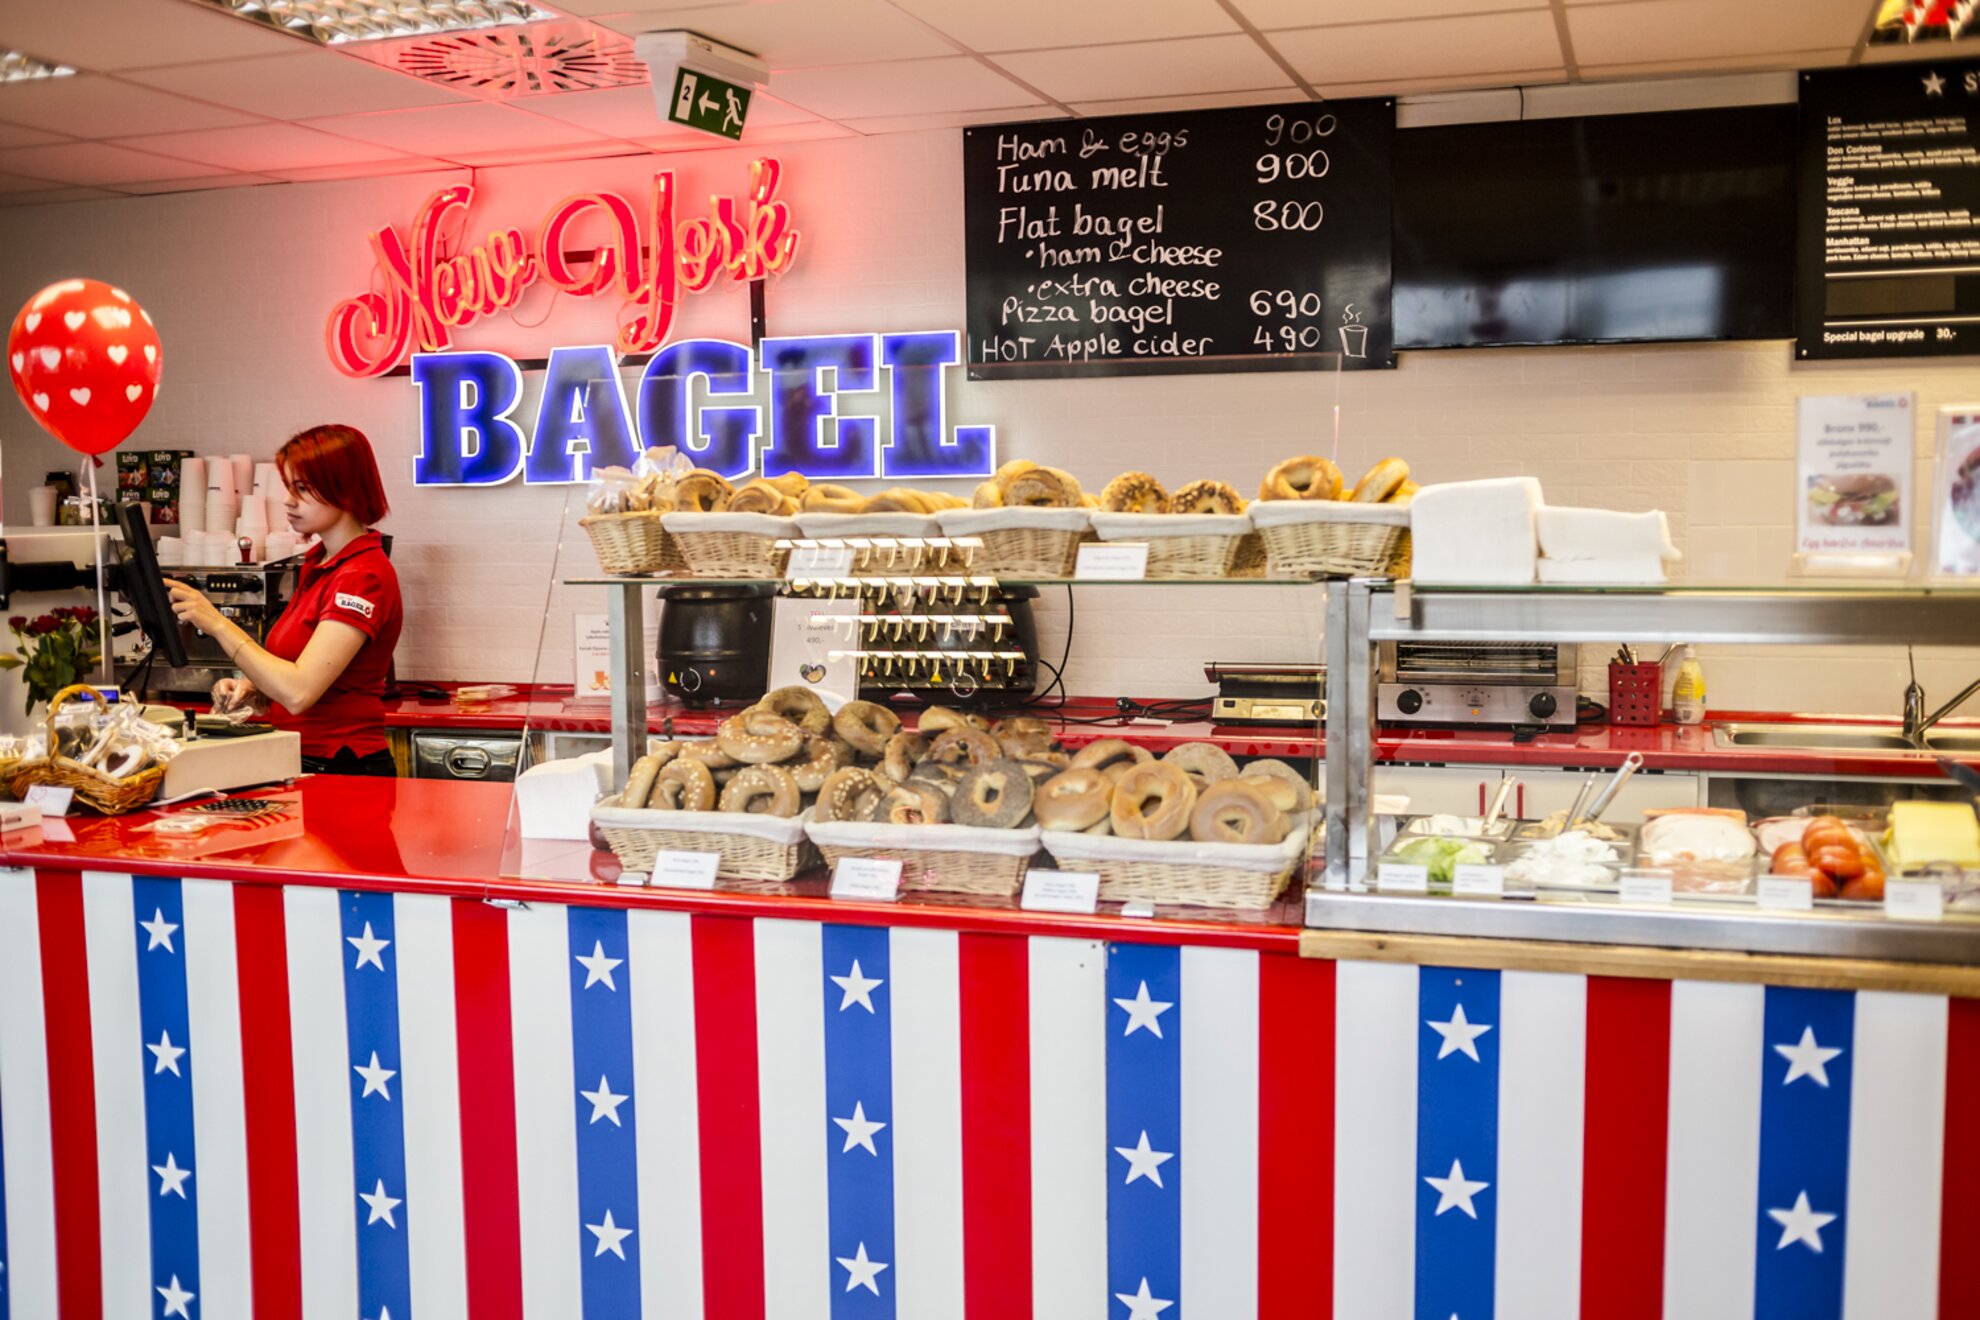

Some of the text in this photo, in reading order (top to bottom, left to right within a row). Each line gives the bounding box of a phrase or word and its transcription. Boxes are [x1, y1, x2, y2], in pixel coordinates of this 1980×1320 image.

[682, 85, 691, 101] 2
[1963, 71, 1980, 93] S
[997, 133, 1066, 162] Ham
[1119, 128, 1190, 158] eggs
[1265, 114, 1337, 147] 900
[997, 149, 1330, 193] Tuna melt 900
[997, 200, 1324, 250] Flat bagel 800
[325, 156, 801, 379] New York
[1131, 238, 1223, 267] cheese
[1036, 271, 1222, 301] extra cheese
[1001, 289, 1322, 335] Pizza bagel 690
[981, 326, 1321, 364] HOT Apple cider 490
[1823, 331, 1858, 344] Special
[1859, 330, 1885, 343] bagel
[1886, 329, 1925, 342] upgrade
[409, 329, 997, 488] BAGEL
